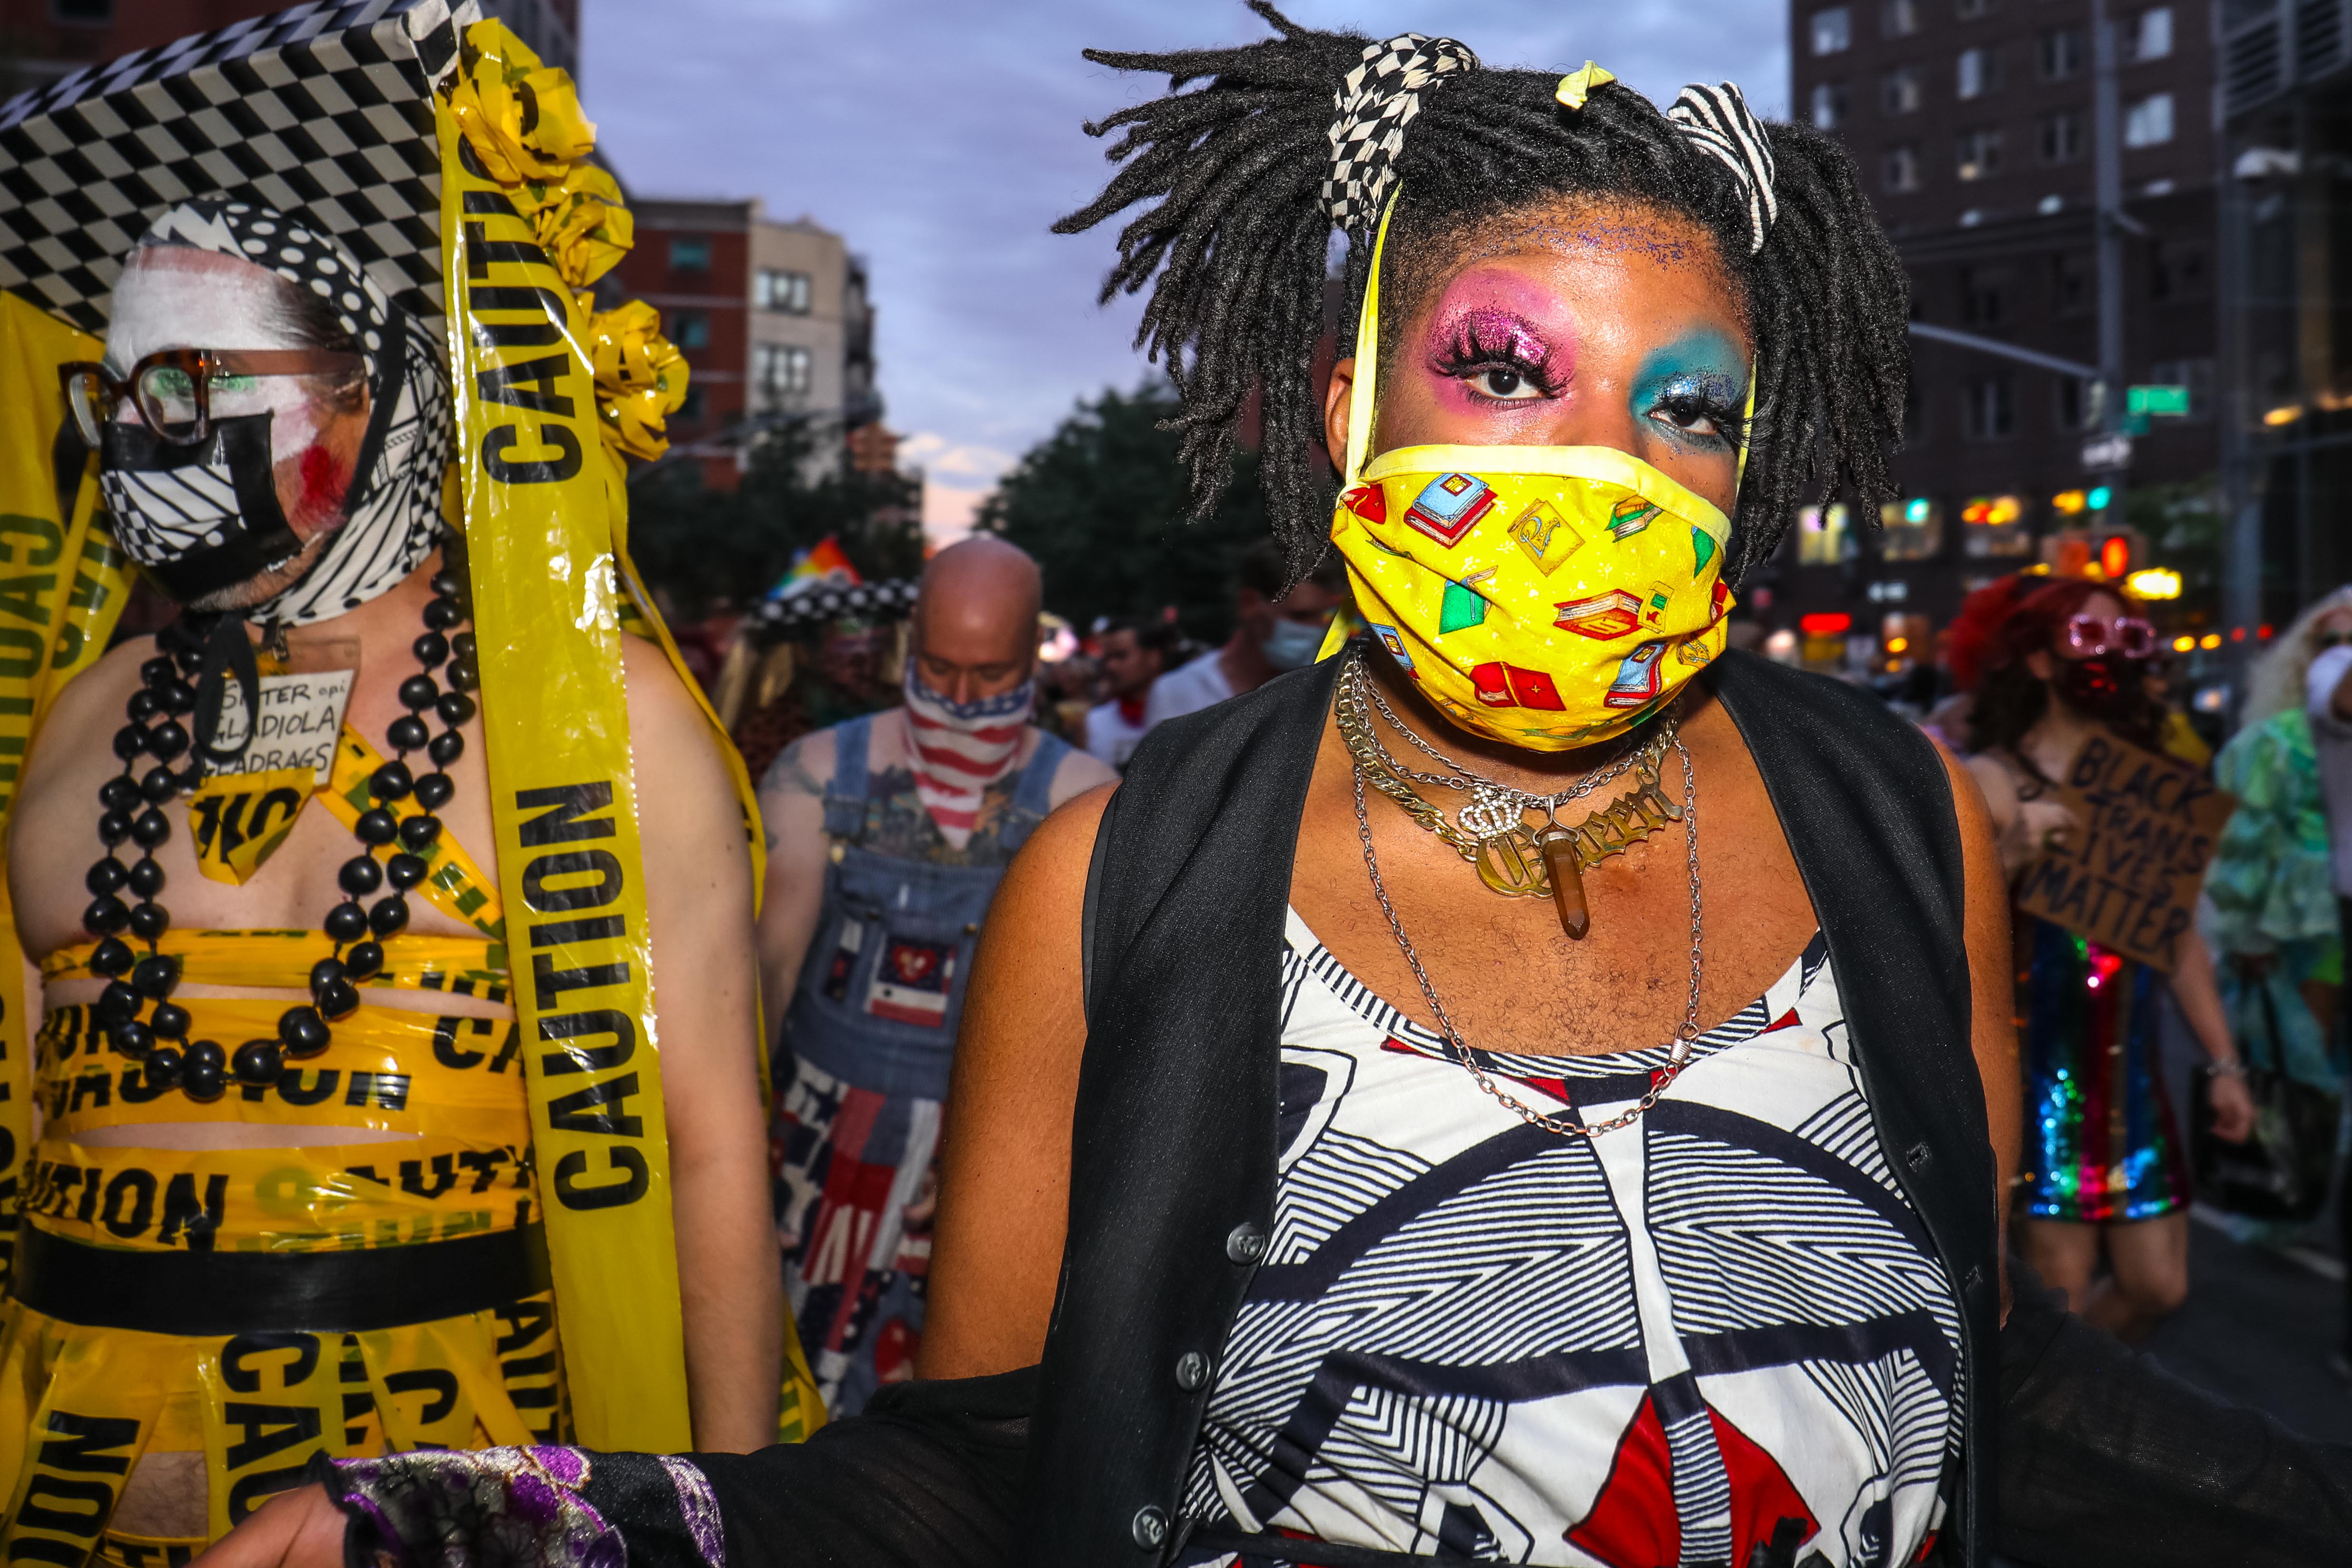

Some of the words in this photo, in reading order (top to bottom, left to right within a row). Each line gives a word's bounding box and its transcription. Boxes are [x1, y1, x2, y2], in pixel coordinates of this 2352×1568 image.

[2072, 738, 2214, 823] BLACK
[2085, 792, 2210, 875] TRANS
[2020, 858, 2191, 964] MATTER
[515, 780, 650, 1212] CAUTION
